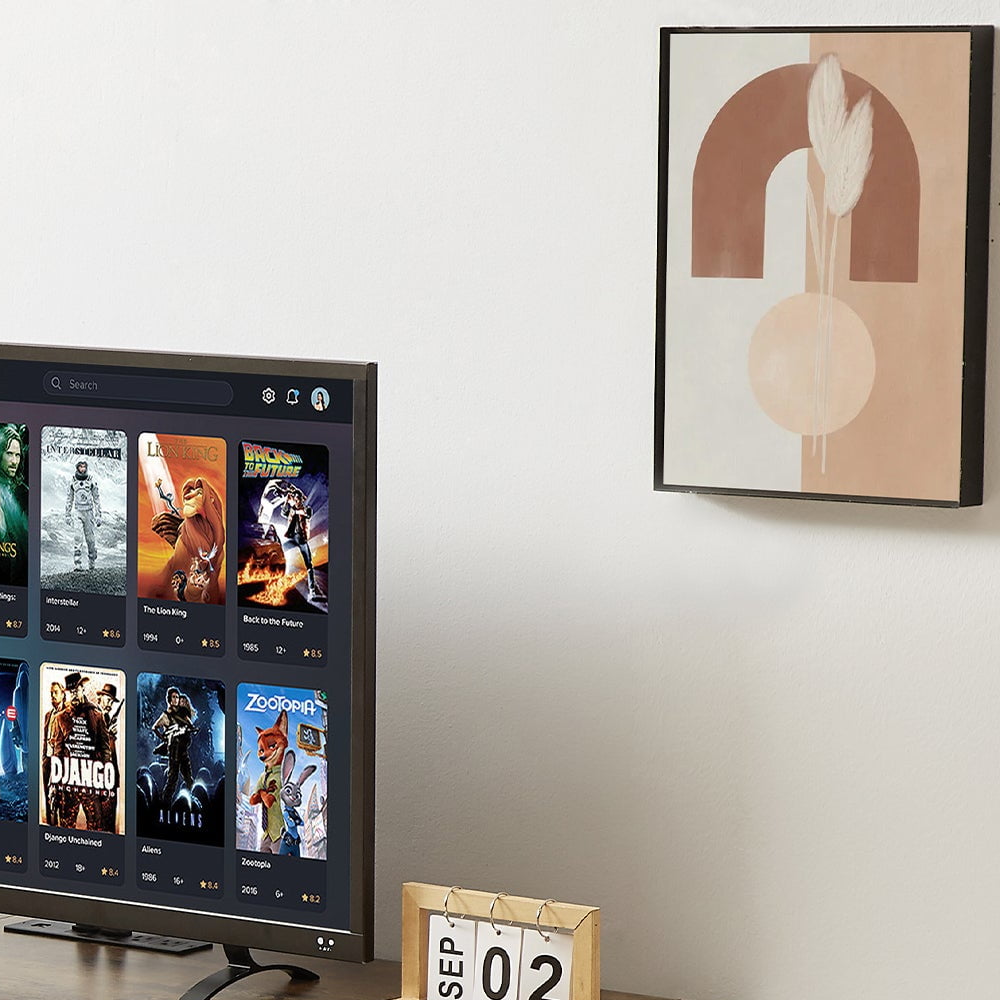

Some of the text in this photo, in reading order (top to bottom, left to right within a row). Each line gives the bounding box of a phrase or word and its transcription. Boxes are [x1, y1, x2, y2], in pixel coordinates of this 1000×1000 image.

[69, 378, 98, 391] Search
[46, 445, 121, 460] INTERSTELLAR
[183, 446, 219, 462] KING
[144, 605, 187, 619] The Lion King
[46, 623, 60, 632] 2014
[243, 615, 304, 628] Back to the Future
[109, 630, 121, 638] 8.6
[143, 633, 158, 642] 1994
[244, 693, 317, 716] ZOOTOPIA
[50, 756, 115, 790] DJANGO
[159, 809, 203, 828] ALIENS
[44, 833, 102, 847] Django Unchained
[141, 845, 162, 855] Aliens
[12, 855, 23, 864] 8.4
[44, 860, 60, 869] 2012
[241, 858, 271, 869] Zootopia
[108, 868, 119, 876] 8.4
[241, 886, 258, 895] 2016
[438, 937, 464, 1000] SEP
